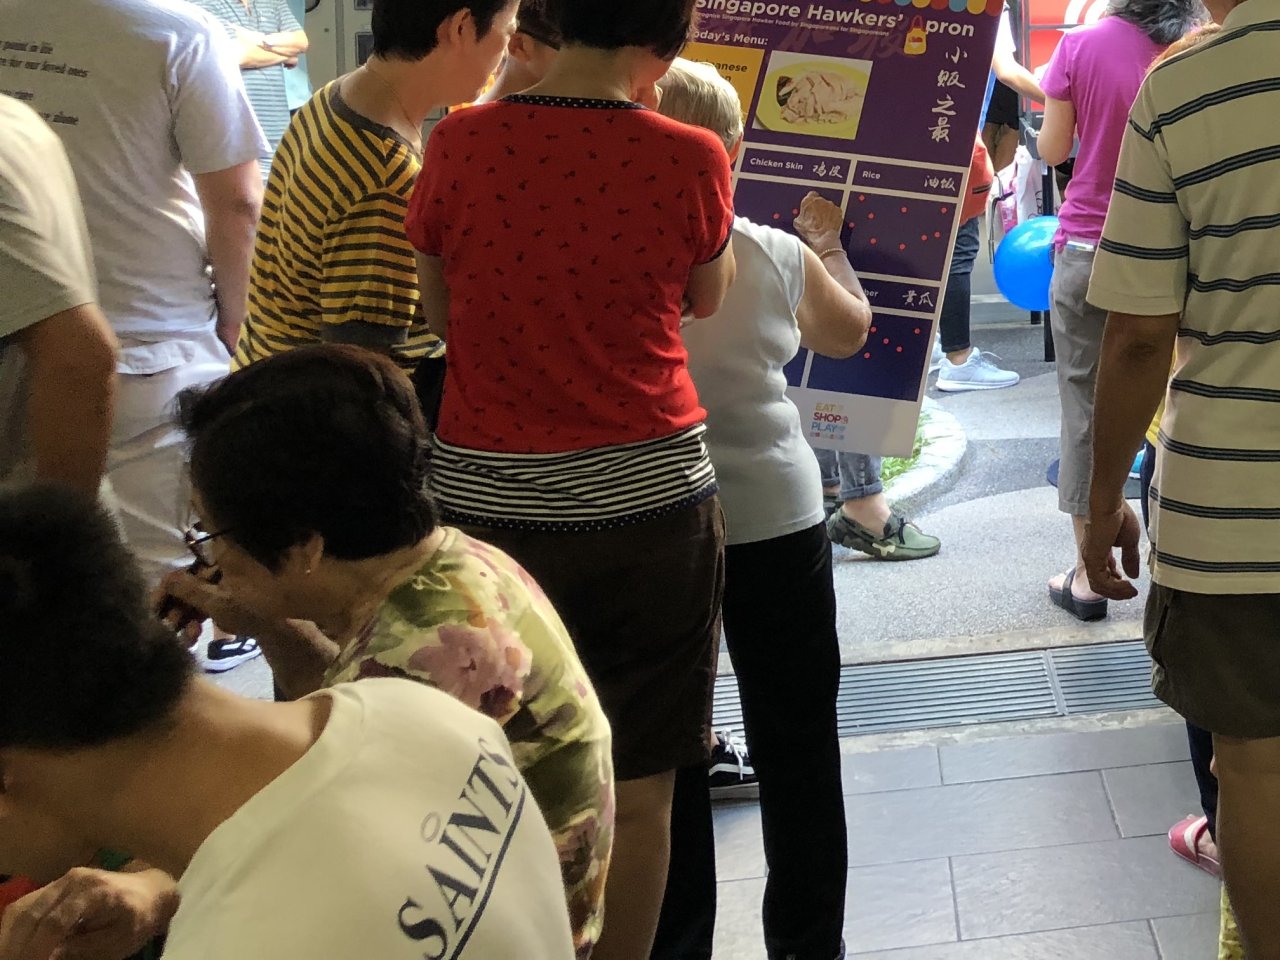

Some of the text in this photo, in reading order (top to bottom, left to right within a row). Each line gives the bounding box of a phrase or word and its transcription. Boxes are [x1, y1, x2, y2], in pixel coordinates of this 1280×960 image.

[807, 4, 904, 28] Hawkers'
[687, 29, 769, 45] oday's Menu:
[928, 46, 967, 142] 小贩之最
[750, 158, 804, 171] Chicken Skin
[862, 170, 881, 179] Rice
[815, 402, 837, 412] EAT
[813, 412, 842, 423] SHOP
[811, 421, 838, 433] PLAY
[397, 737, 519, 960] SAINTS
